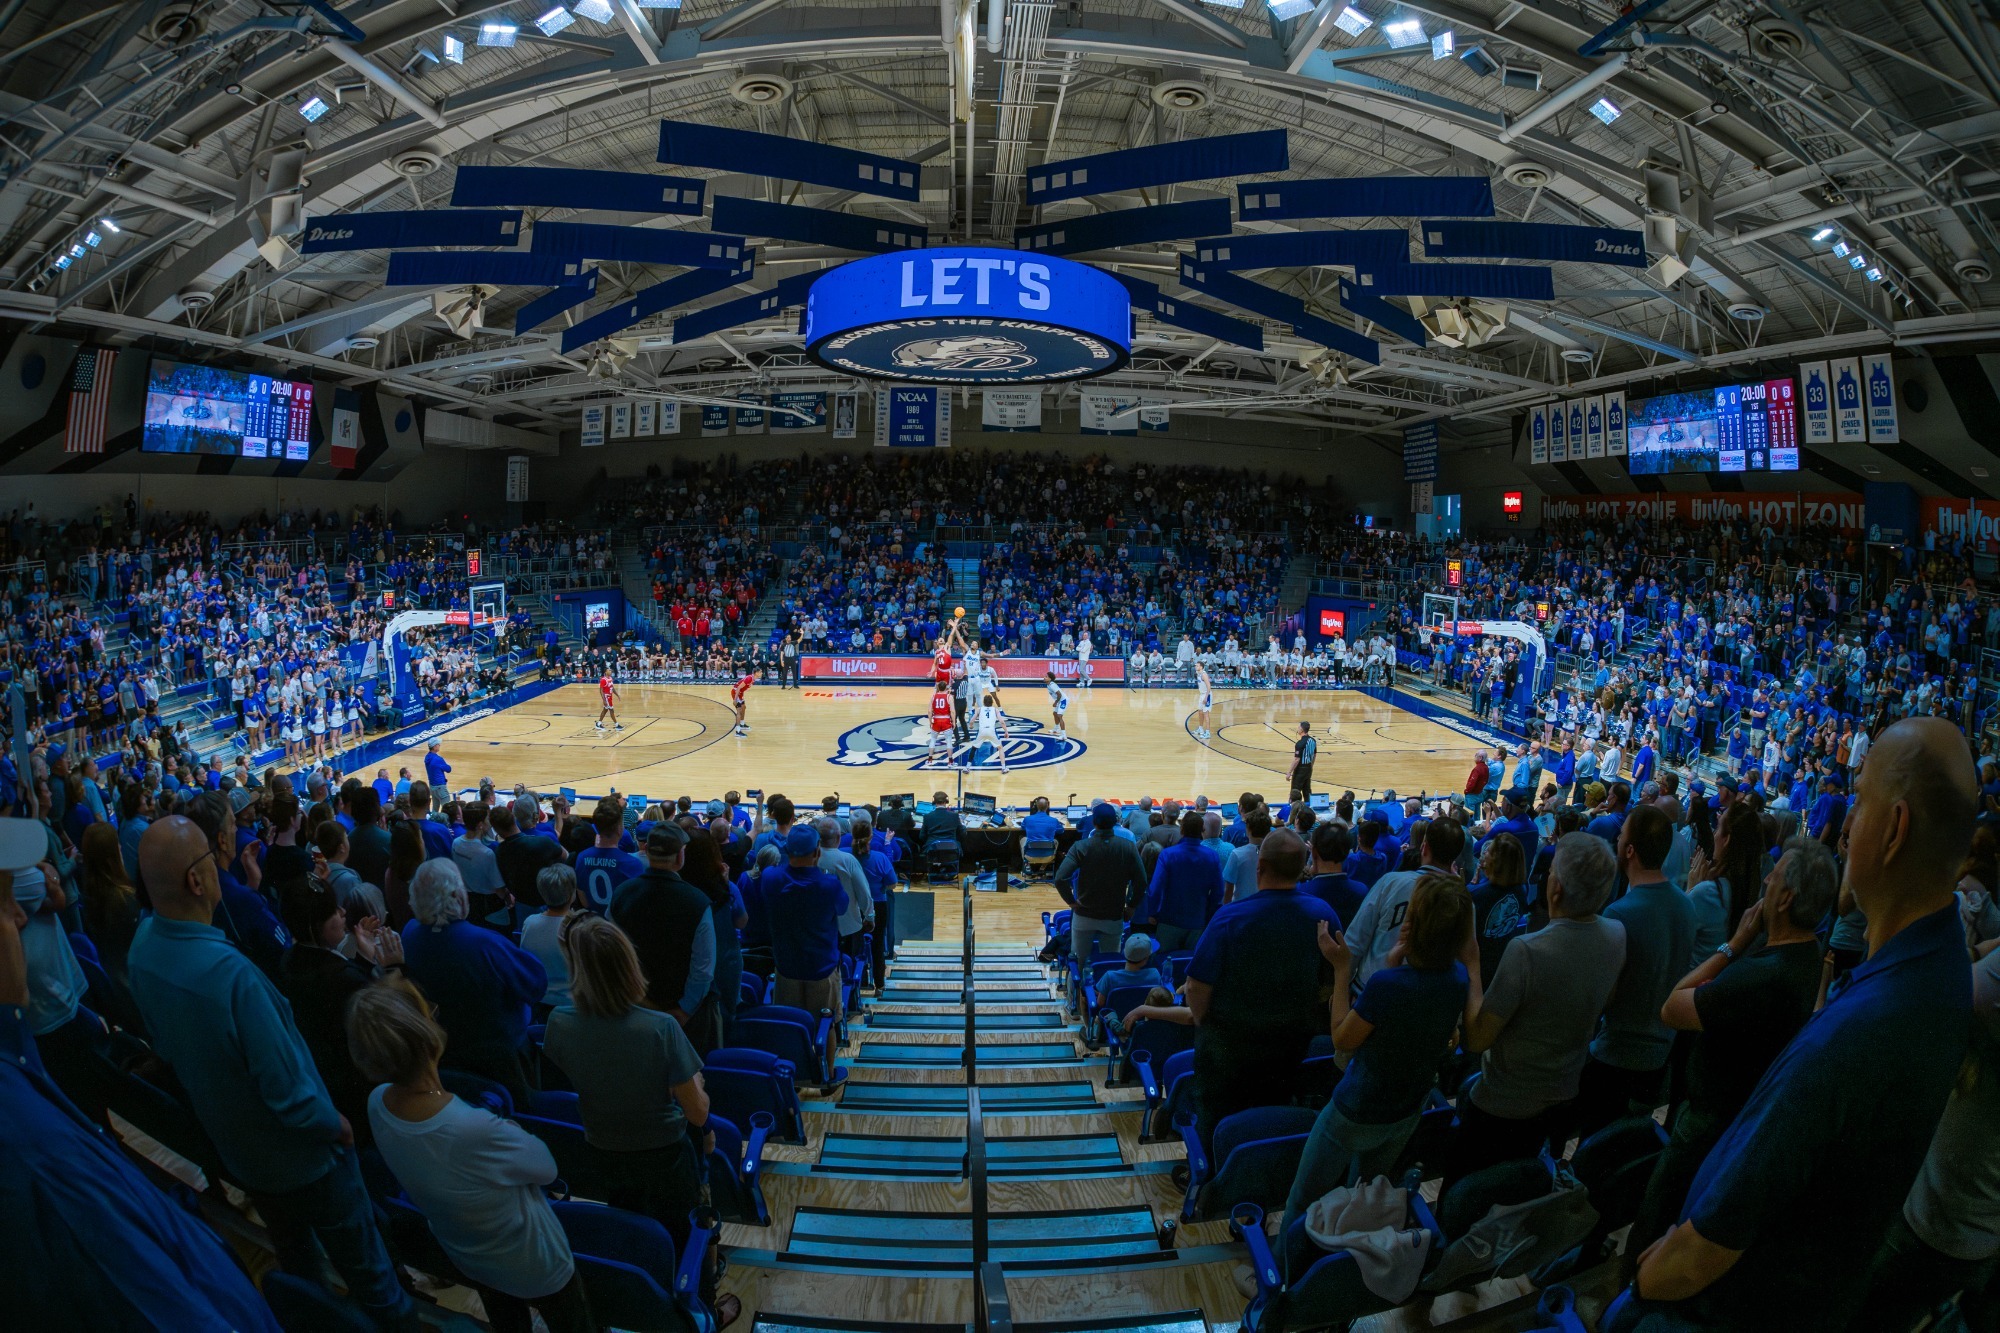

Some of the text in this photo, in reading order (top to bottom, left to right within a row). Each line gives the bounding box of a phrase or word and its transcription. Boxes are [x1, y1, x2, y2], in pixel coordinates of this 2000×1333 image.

[308, 227, 354, 242] Drake
[1594, 238, 1640, 256] Drake
[900, 258, 1050, 311] LET'S
[828, 318, 1110, 359] WELCOME TO THE KNAPP CENTER
[271, 380, 293, 397] 20:00
[1741, 384, 1766, 401] 20:00
[1809, 386, 1824, 403] 33
[1840, 383, 1855, 400] 13
[1872, 380, 1888, 398] 55
[897, 392, 928, 402] NCAA
[640, 405, 651, 415] NIT
[664, 403, 675, 413] NIT
[906, 405, 920, 414] 1969
[1844, 410, 1855, 419] JAN
[1571, 416, 1581, 429] 42
[1590, 414, 1599, 428] 30
[1610, 411, 1621, 425] 33
[1808, 412, 1827, 420] WANDA
[1536, 423, 1541, 435] 5
[1553, 420, 1562, 432] 15
[1812, 421, 1826, 429] FORD
[1841, 420, 1860, 428] JENSEN
[1504, 496, 1520, 508] HyVee
[1586, 501, 1621, 519] HOT
[1625, 500, 1676, 520] ZONE
[1691, 498, 1743, 521] HyVee
[1748, 500, 1796, 525] HOT
[469, 560, 478, 574] 30
[1448, 562, 1460, 571] 20:00
[1450, 570, 1458, 584] 30
[1322, 617, 1341, 628] HyVee
[832, 659, 877, 676] HyVee
[935, 698, 945, 709] 10
[985, 711, 990, 719] 4
[584, 857, 617, 868] WILKINS
[589, 868, 613, 905] 0
